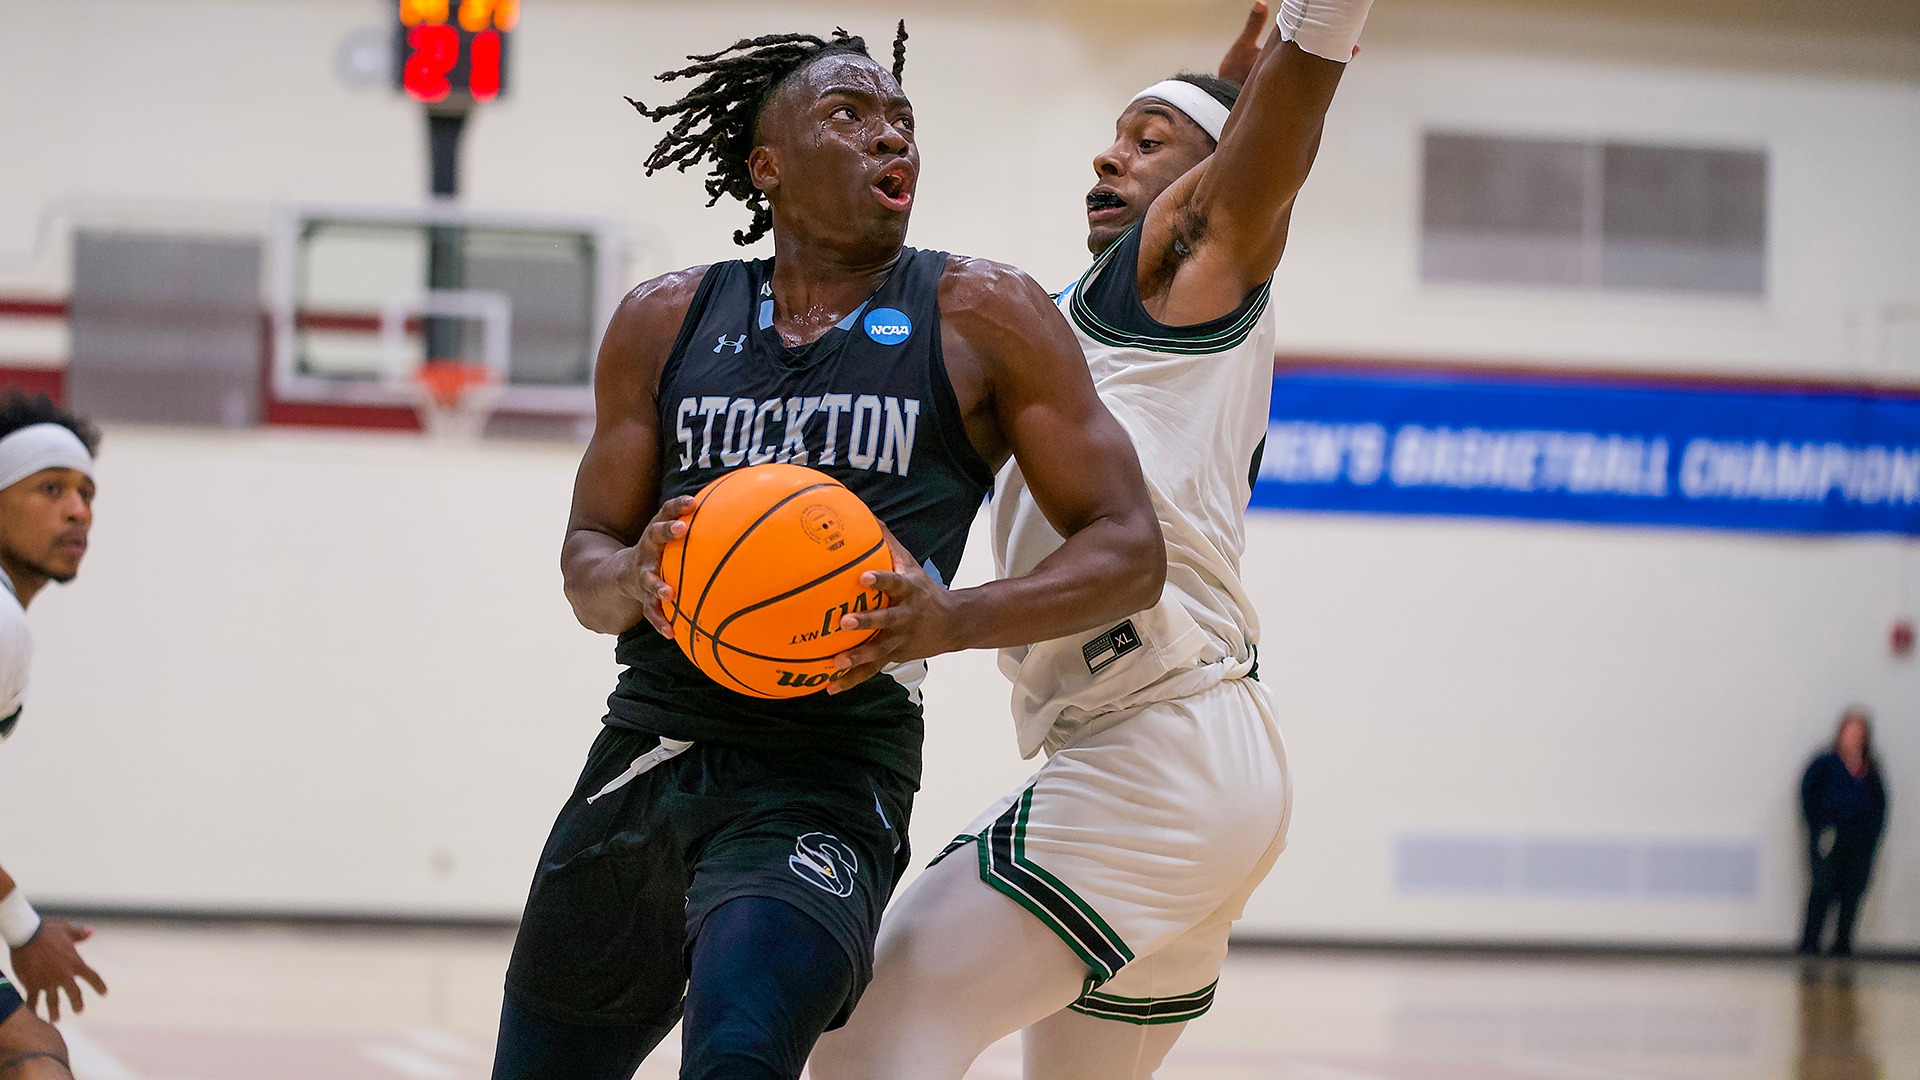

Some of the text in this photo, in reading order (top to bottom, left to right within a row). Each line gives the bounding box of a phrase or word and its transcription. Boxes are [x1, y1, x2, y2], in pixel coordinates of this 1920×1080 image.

[870, 324, 910, 336] NCAA
[676, 392, 920, 477] STOCKTON
[1389, 423, 1670, 497] BASKETBALL
[788, 630, 819, 646] NXT
[1114, 632, 1134, 648] XL
